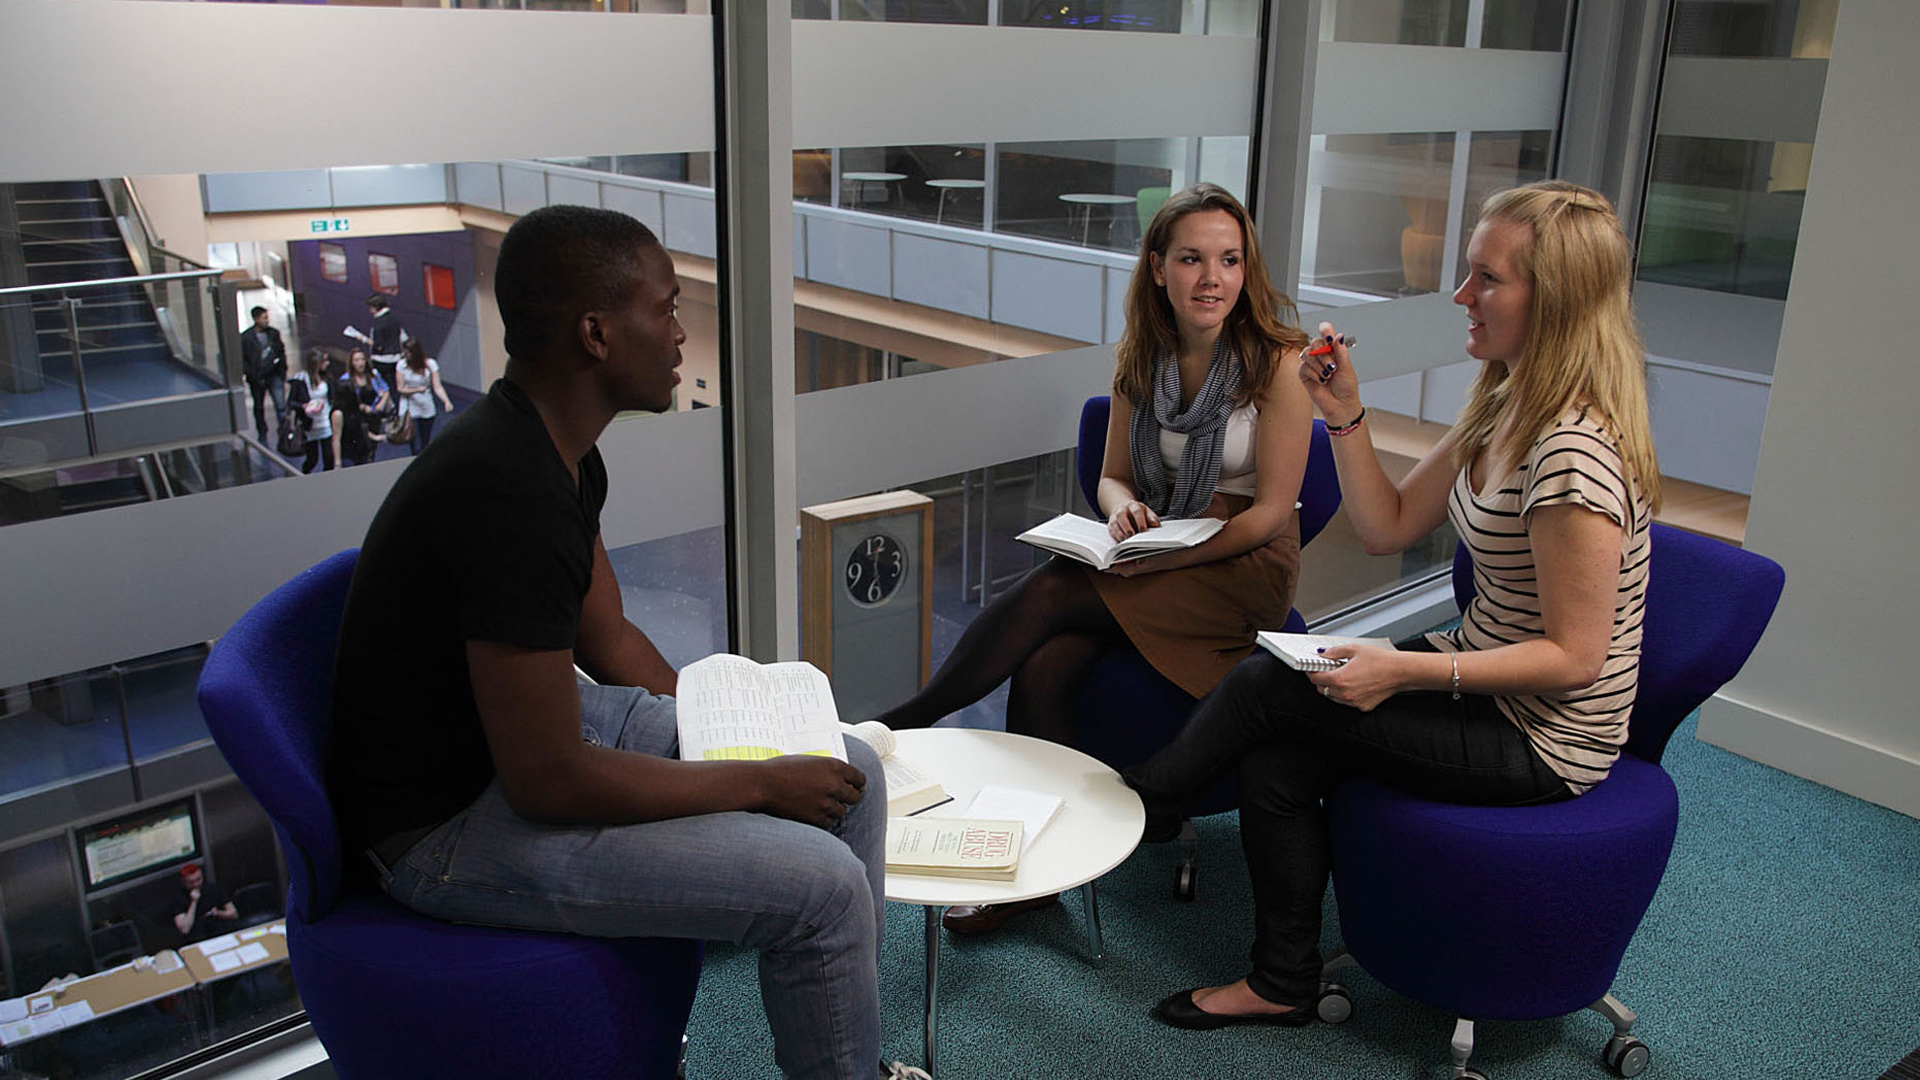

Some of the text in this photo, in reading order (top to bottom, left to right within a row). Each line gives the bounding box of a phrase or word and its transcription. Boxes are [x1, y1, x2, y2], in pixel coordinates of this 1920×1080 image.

[866, 536, 886, 555] 12
[848, 562, 862, 589] 9
[891, 551, 901, 577] 3
[867, 577, 882, 602] 6
[960, 827, 987, 859] ABUSE
[984, 831, 1010, 857] DRUG
